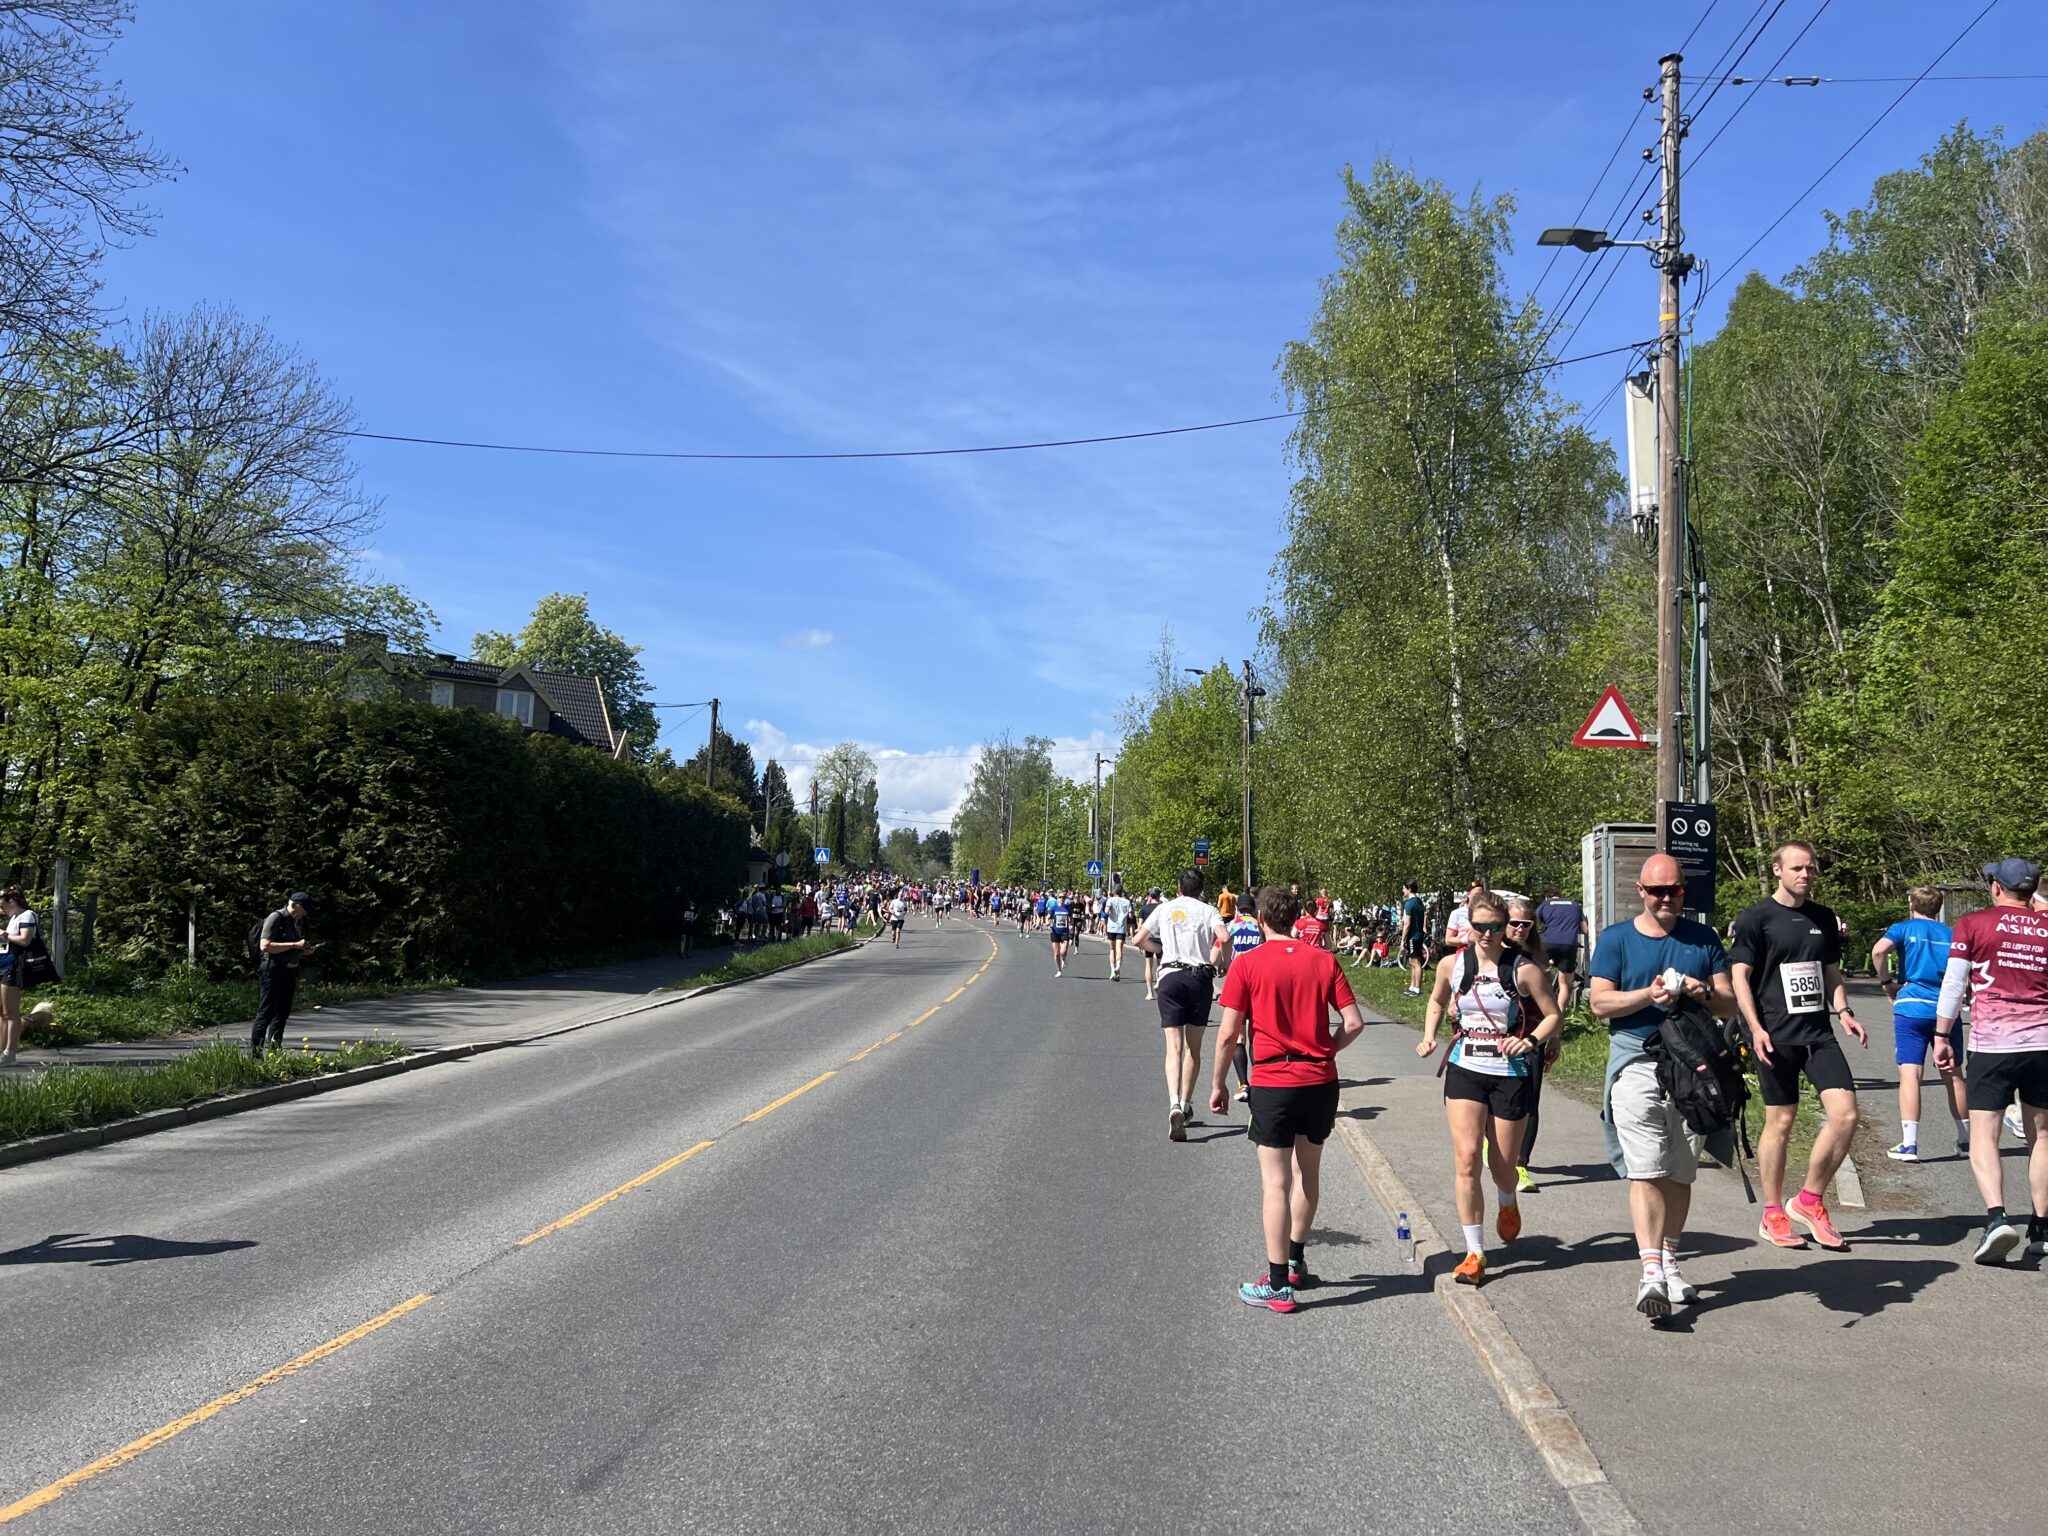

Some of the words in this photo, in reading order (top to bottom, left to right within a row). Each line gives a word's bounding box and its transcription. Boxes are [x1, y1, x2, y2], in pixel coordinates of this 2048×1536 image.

[2000, 913, 2040, 925] AKTIV
[1234, 936, 1260, 945] MAPEI
[1997, 951, 2034, 961] sunnhet
[2036, 956, 2047, 964] og
[1998, 959, 2044, 972] folkehelse
[1790, 976, 1820, 992] 5850
